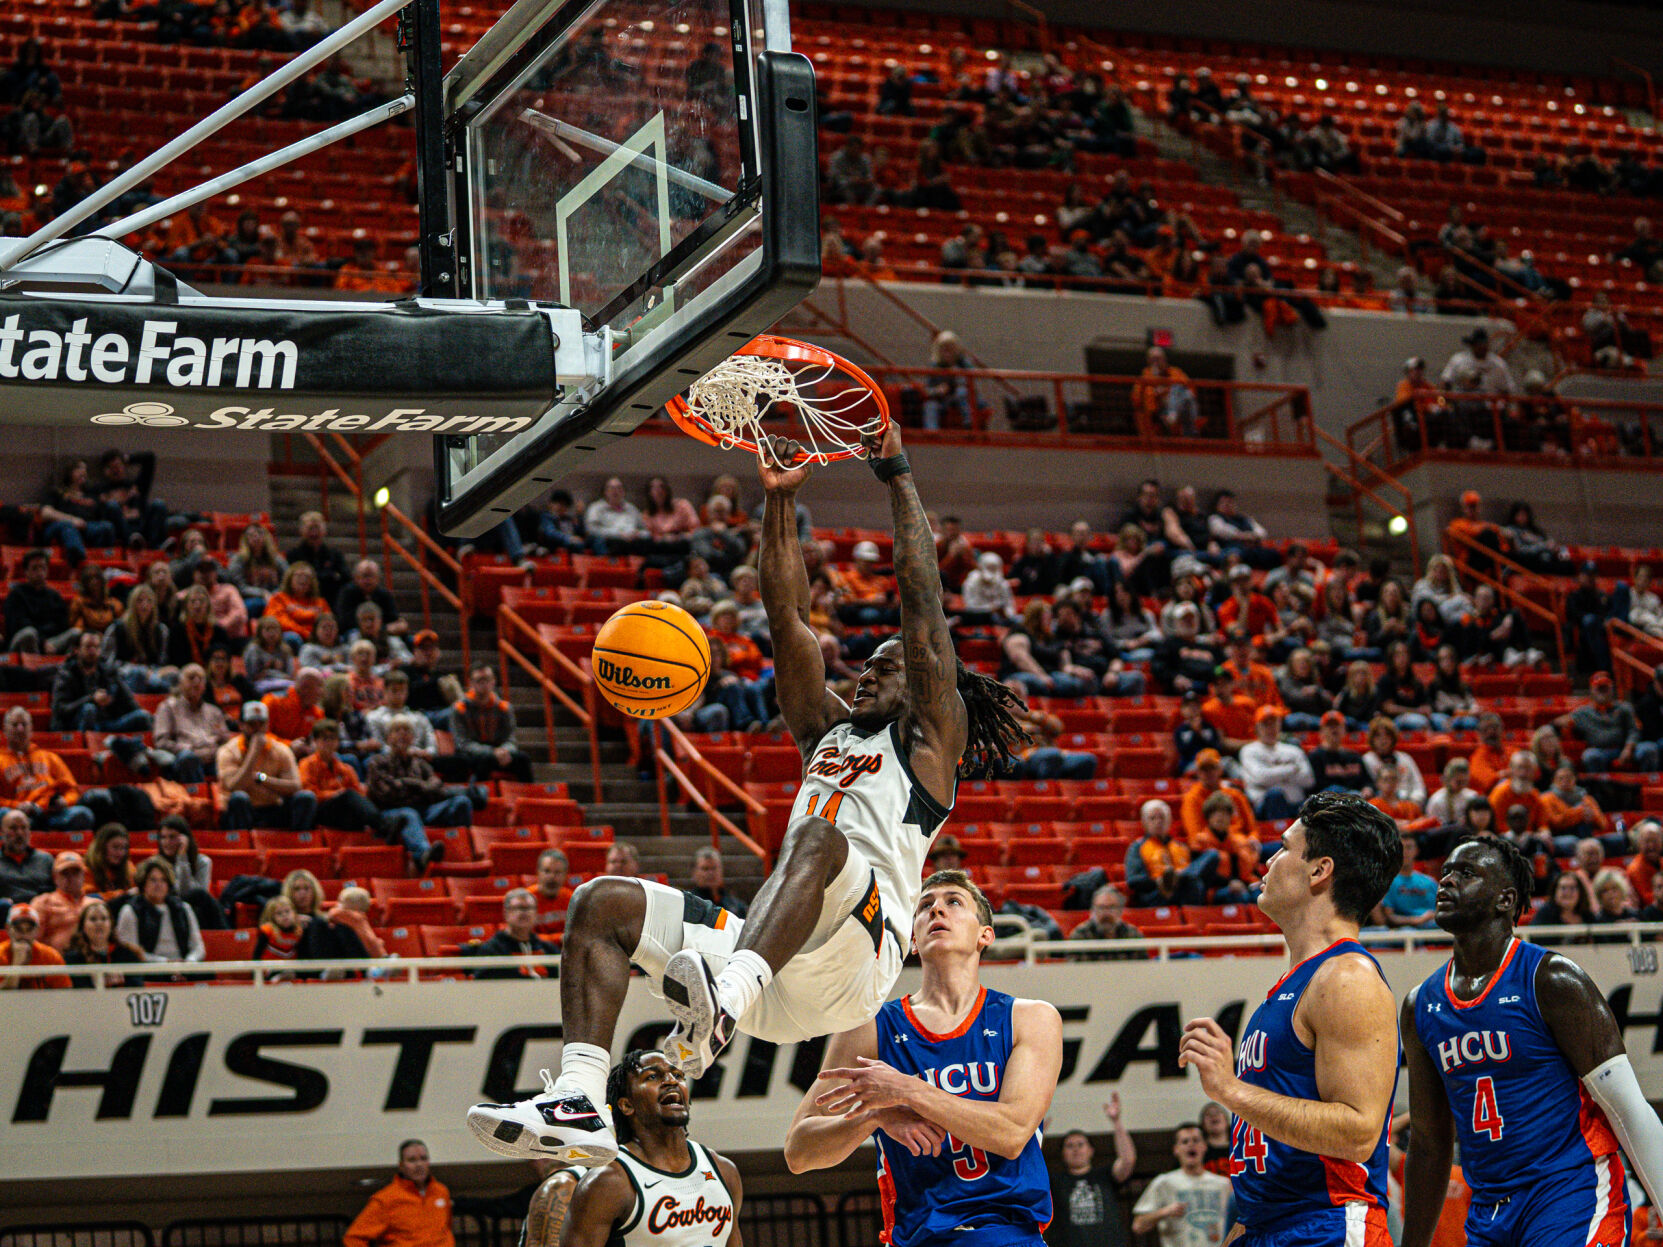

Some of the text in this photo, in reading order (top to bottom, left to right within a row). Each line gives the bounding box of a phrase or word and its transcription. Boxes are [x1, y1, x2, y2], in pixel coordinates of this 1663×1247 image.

[598, 656, 672, 690] Wilson
[127, 992, 169, 1027] 107
[1437, 1030, 1512, 1074] HCU
[1472, 1075, 1504, 1142] 4
[648, 1195, 732, 1238] Cowboys
